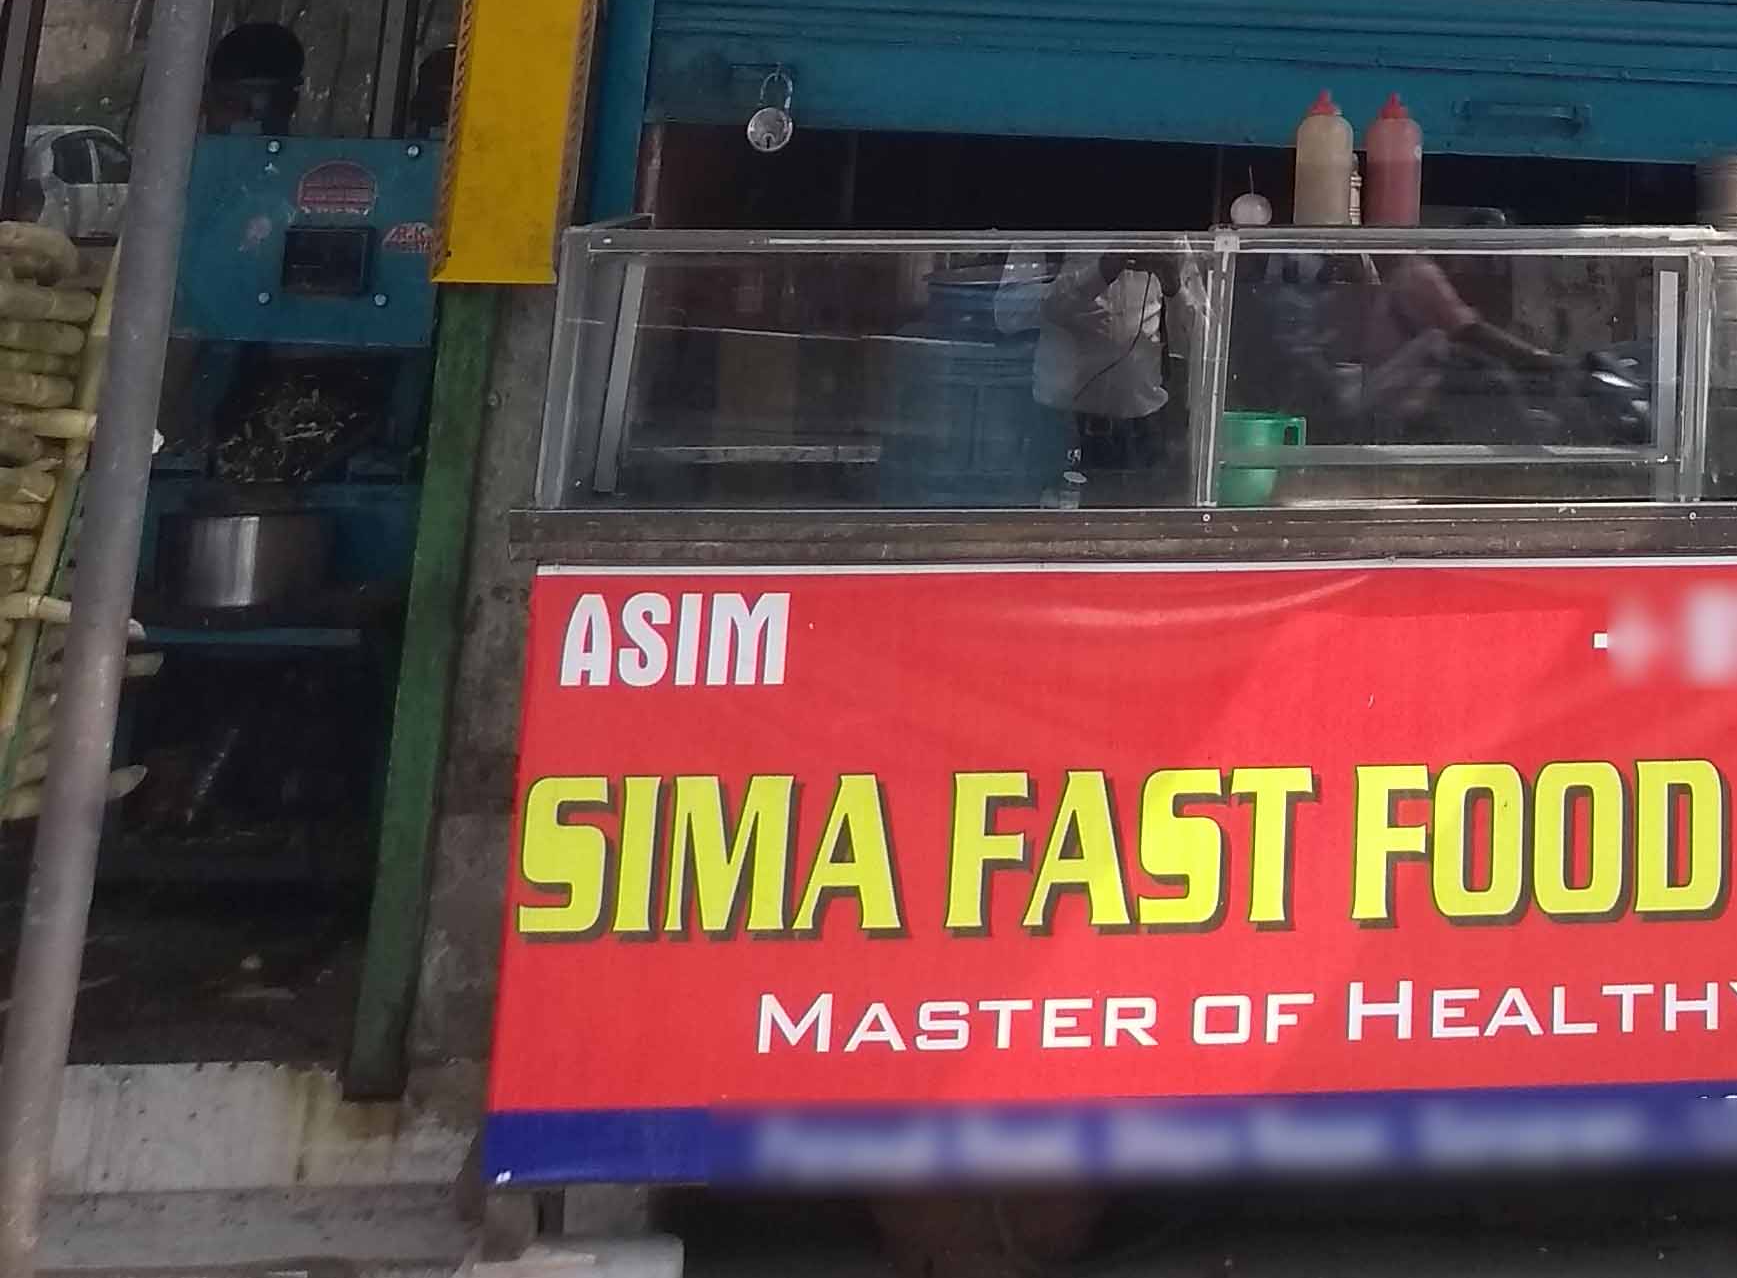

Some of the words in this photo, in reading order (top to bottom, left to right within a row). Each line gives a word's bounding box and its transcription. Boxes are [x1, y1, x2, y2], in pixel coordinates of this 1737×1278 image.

[559, 592, 791, 687] ASIM
[517, 773, 911, 939] SIMA
[944, 768, 1320, 937] FAST
[1350, 759, 1730, 928] FOOD
[756, 992, 1159, 1054] MASTER
[1192, 992, 1315, 1045] OF
